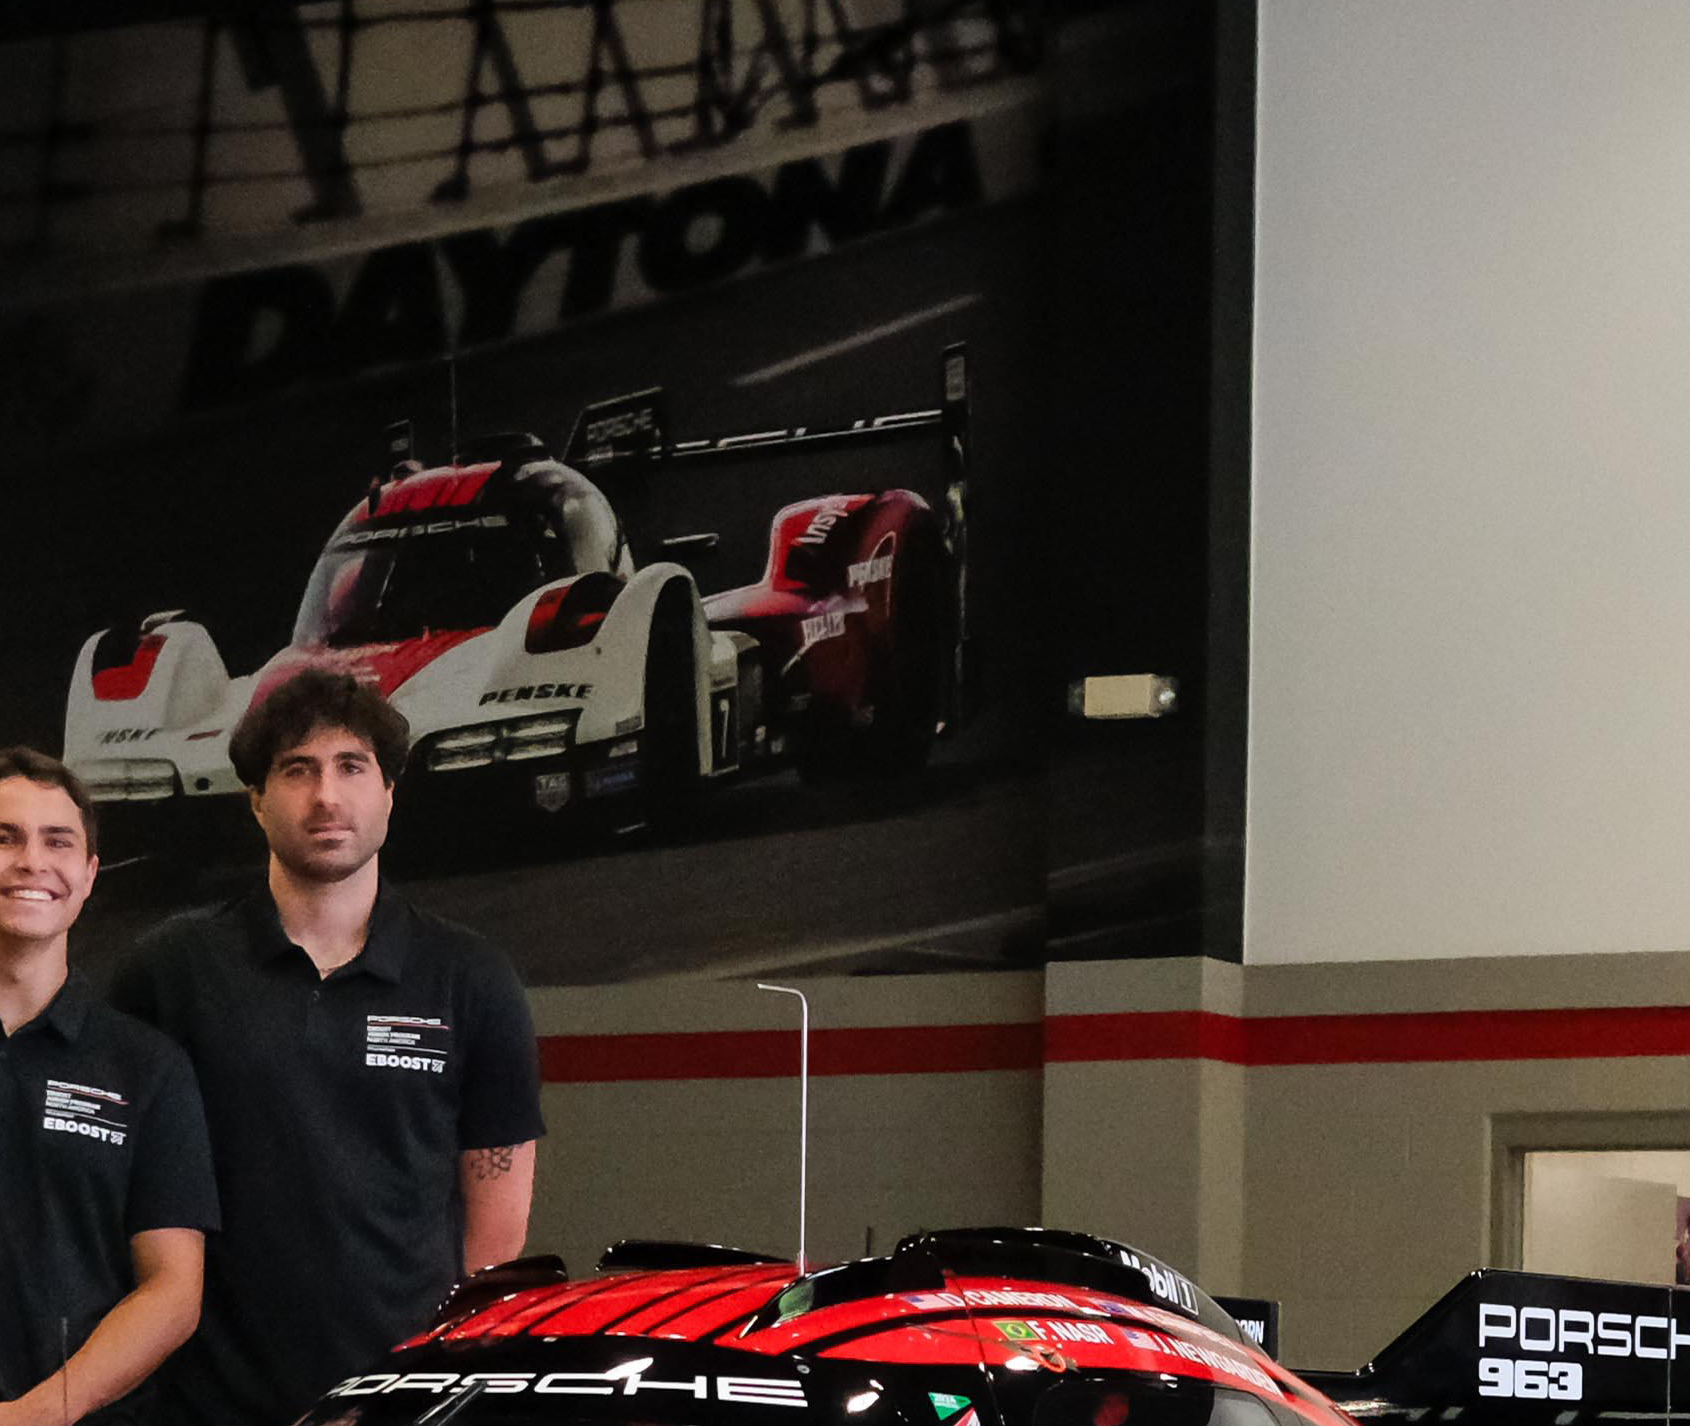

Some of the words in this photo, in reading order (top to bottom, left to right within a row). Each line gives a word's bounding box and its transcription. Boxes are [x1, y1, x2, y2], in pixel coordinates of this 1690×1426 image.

[183, 124, 983, 410] DAYTONA
[479, 683, 593, 706] PENSKE
[366, 1053, 432, 1071] EBOOST
[43, 1117, 111, 1142] EBOOST
[327, 1373, 809, 1407] PORSCHE
[1479, 1358, 1583, 1400] 963
